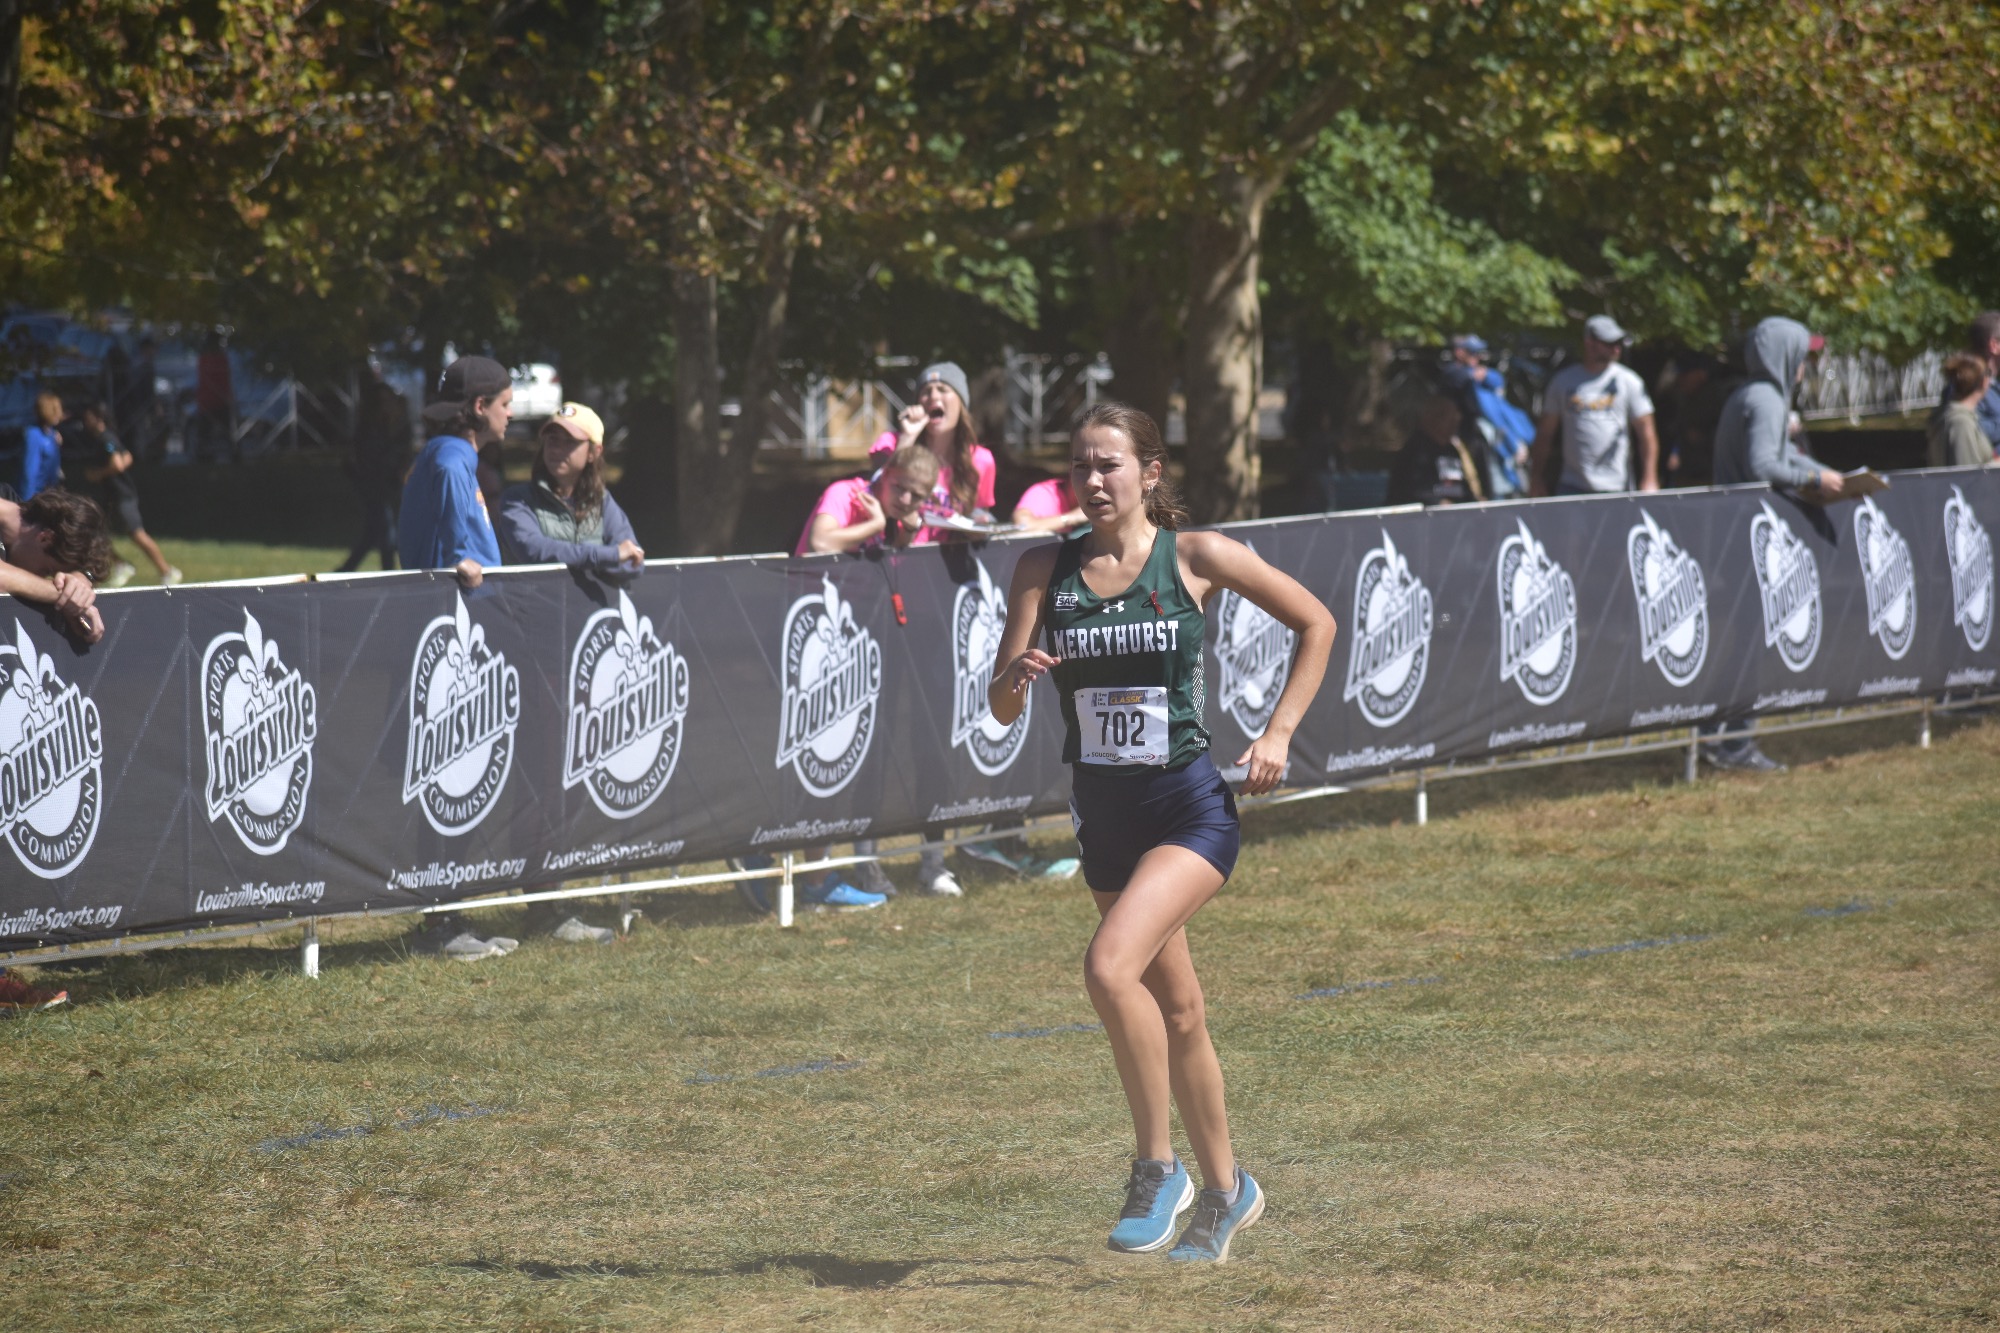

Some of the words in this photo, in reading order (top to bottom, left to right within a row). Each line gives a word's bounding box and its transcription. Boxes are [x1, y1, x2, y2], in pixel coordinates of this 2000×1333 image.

[418, 633, 445, 704] SPORTS
[578, 625, 613, 693] SPORTS
[789, 610, 815, 676] SPORTS
[1054, 620, 1179, 660] MERCYHURST
[209, 650, 236, 720] SPORTS
[566, 644, 689, 783] Louisville
[778, 628, 881, 763] Louisville
[1110, 696, 1143, 704] CLASSIC
[0, 692, 101, 820] ouisville
[208, 670, 315, 817] Louisville
[405, 655, 519, 796] Louisville
[803, 712, 870, 784] COMMISSION
[1095, 711, 1146, 747] 702
[235, 766, 306, 841] COMMISSION
[429, 746, 507, 822] COMMISSION
[597, 733, 676, 806] COMMISSION
[18, 782, 96, 863] COMMISSION
[195, 879, 325, 914] LouisvilleSports.org
[386, 856, 527, 891] LouisvilleSports.org
[0, 905, 122, 937] isvilleSports.org
